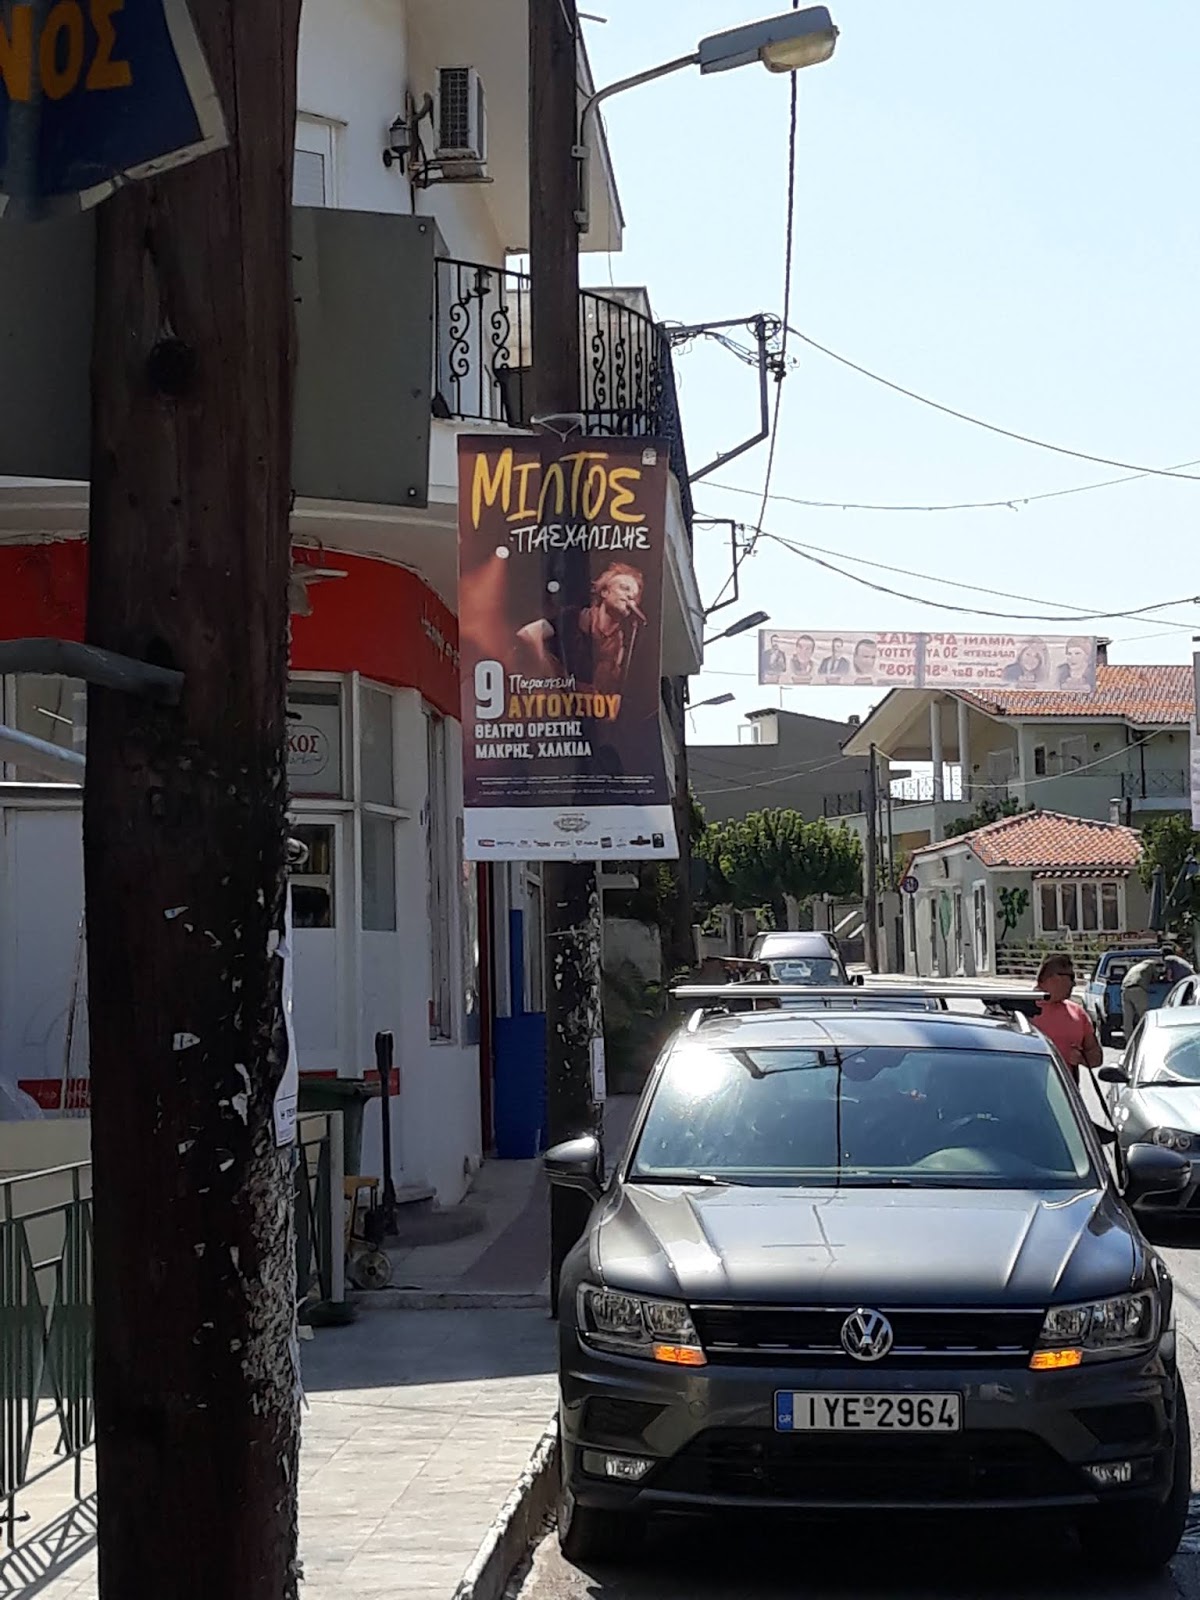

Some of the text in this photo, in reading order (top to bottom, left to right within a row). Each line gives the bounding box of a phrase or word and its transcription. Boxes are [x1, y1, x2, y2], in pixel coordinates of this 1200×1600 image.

[471, 447, 646, 530] ΜΙΛΤΟΣ
[509, 523, 651, 552] ΠΑΣΧΑΛΙΔΗΣ
[474, 659, 505, 720] 9
[508, 674, 577, 693] Παρασκευή
[508, 693, 622, 720] ΑΥΓΟΥΣΤΟΥ
[474, 721, 583, 739] ΘΕΑΤΡΟ ΟΡΕΣΤΗΣ
[475, 741, 592, 759] ΜΑΚΡΗΣ, ΧΑΛΚΙΔΑ
[778, 1414, 792, 1423] GR
